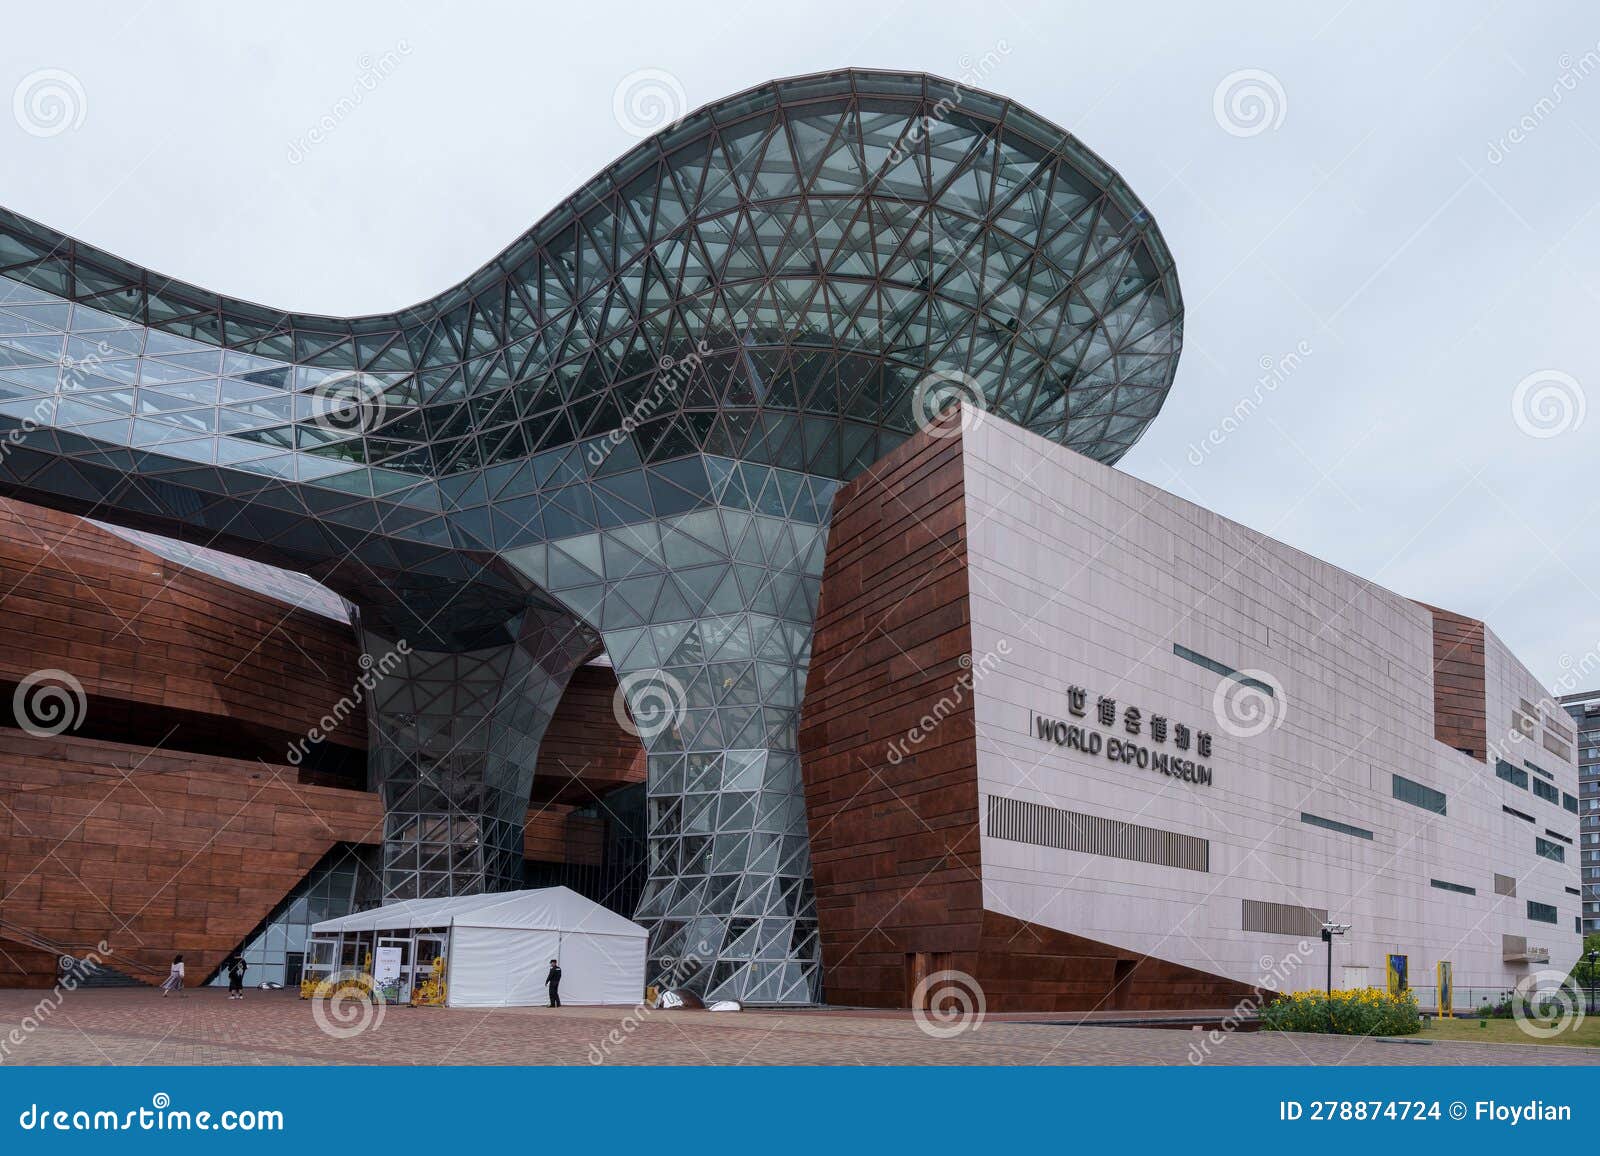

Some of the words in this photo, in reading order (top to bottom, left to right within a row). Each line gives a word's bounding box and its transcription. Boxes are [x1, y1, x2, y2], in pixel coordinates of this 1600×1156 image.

[1036, 715, 1103, 756] WORLD
[1106, 736, 1149, 769] EXPO
[1151, 750, 1213, 787] MUSEUM
[1067, 684, 1213, 758] 世博会博物馆
